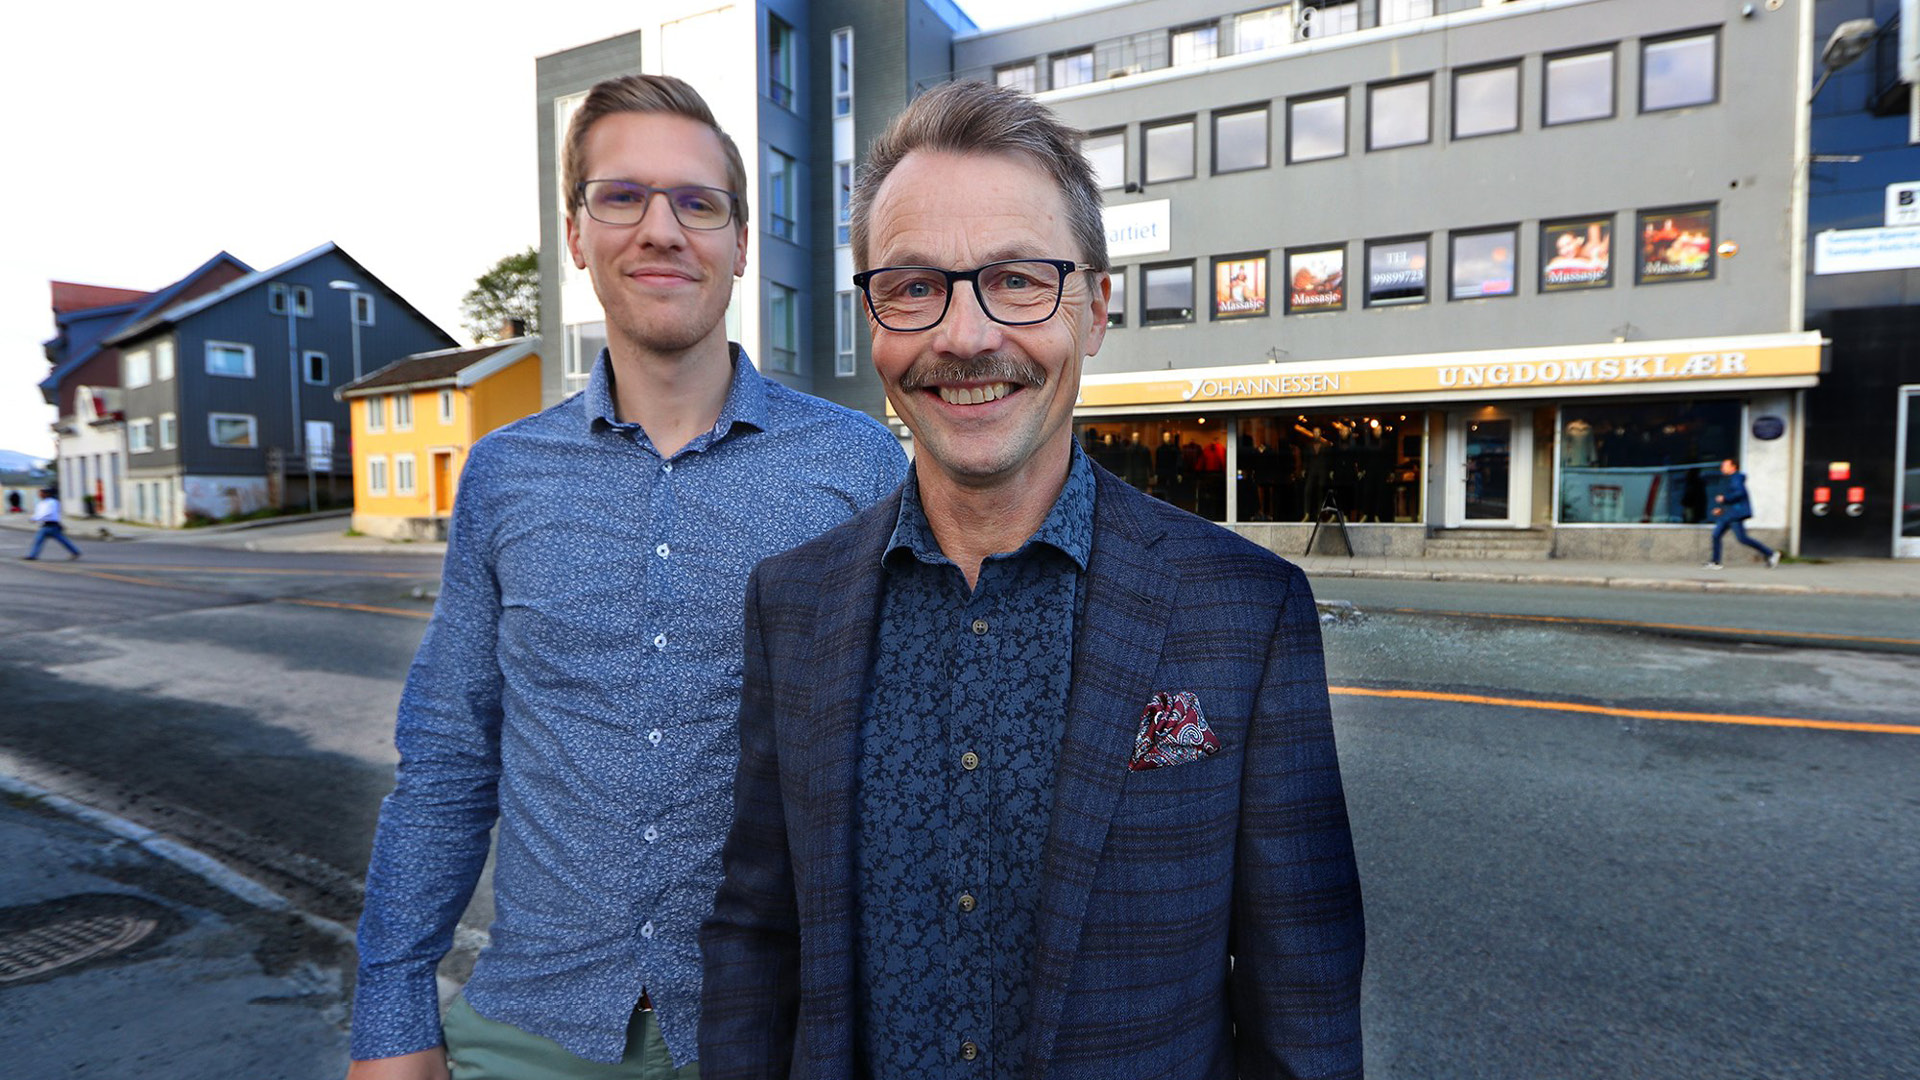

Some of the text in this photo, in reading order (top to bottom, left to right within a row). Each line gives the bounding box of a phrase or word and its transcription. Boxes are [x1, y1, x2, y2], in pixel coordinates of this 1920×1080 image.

[1105, 222, 1158, 244] artiet
[1373, 269, 1424, 286] 99899723
[1220, 298, 1262, 313] Massasje
[1294, 290, 1338, 305] Massasje
[1437, 351, 1749, 388] UNGDOMSKLÆR
[1182, 374, 1340, 401] JOHANNESSEN
